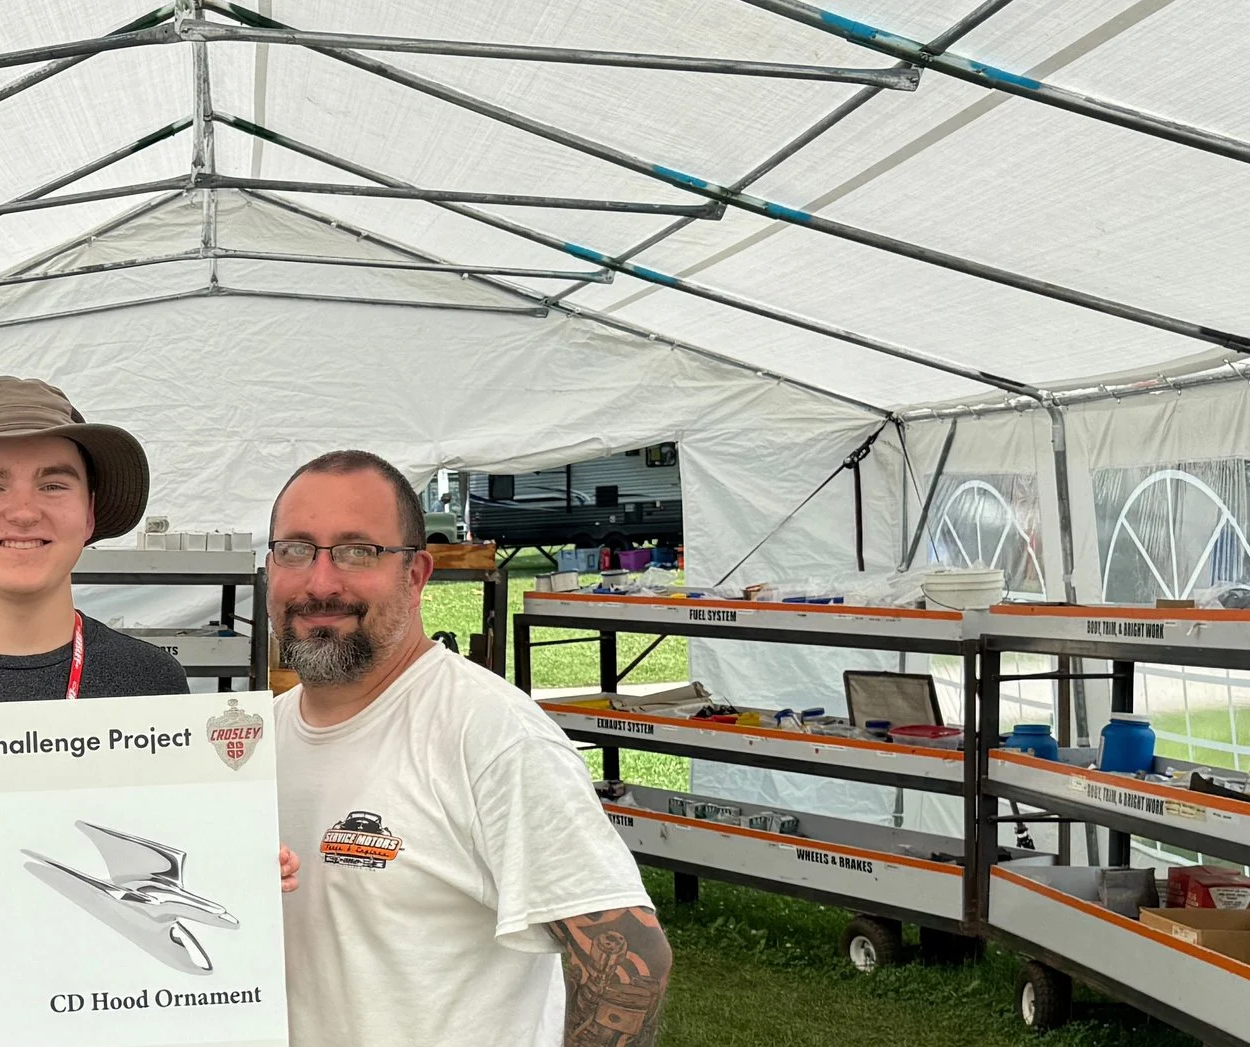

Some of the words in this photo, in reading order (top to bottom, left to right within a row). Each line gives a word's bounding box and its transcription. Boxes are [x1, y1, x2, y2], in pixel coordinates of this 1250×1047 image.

[689, 609, 706, 621] FUEL
[707, 610, 737, 622] SYSTEM
[1145, 623, 1165, 639] WORK
[210, 727, 263, 741] CROSLEY
[597, 718, 626, 731] EXHAUST
[627, 722, 654, 734] SYSTEM
[109, 727, 192, 754] Project
[1145, 797, 1165, 816] WORK
[325, 833, 356, 845] SERVICE
[357, 834, 398, 850] MOTORS
[796, 848, 829, 864] WHEELS
[830, 855, 837, 865] &
[839, 856, 873, 873] BRAKES
[50, 993, 85, 1013] CD
[91, 989, 149, 1011] Hood
[155, 986, 262, 1008] Ornament
